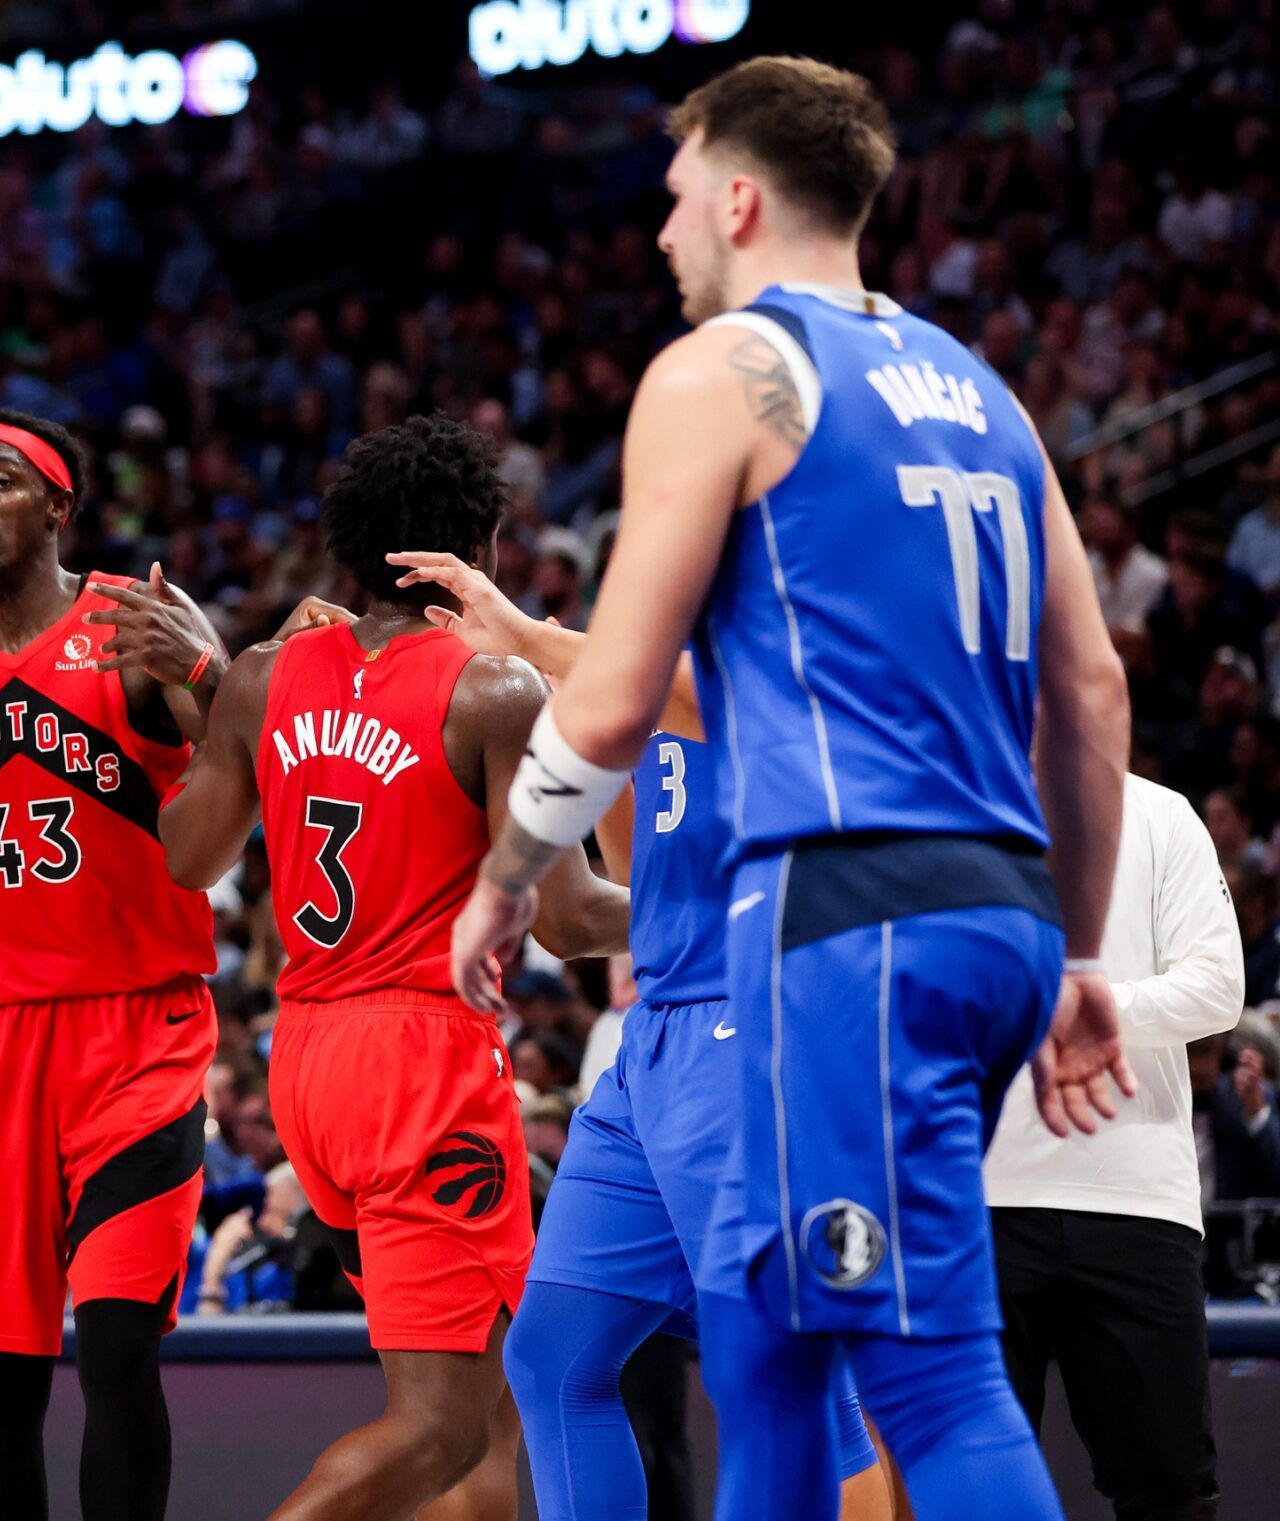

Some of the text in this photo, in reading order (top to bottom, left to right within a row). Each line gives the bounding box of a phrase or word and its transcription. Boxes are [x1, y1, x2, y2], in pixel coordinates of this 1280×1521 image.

[896, 465, 1030, 661] 77
[55, 661, 77, 671] Sun
[272, 709, 420, 786] ANUNOBY
[656, 742, 686, 833] 3
[293, 796, 363, 949] 3
